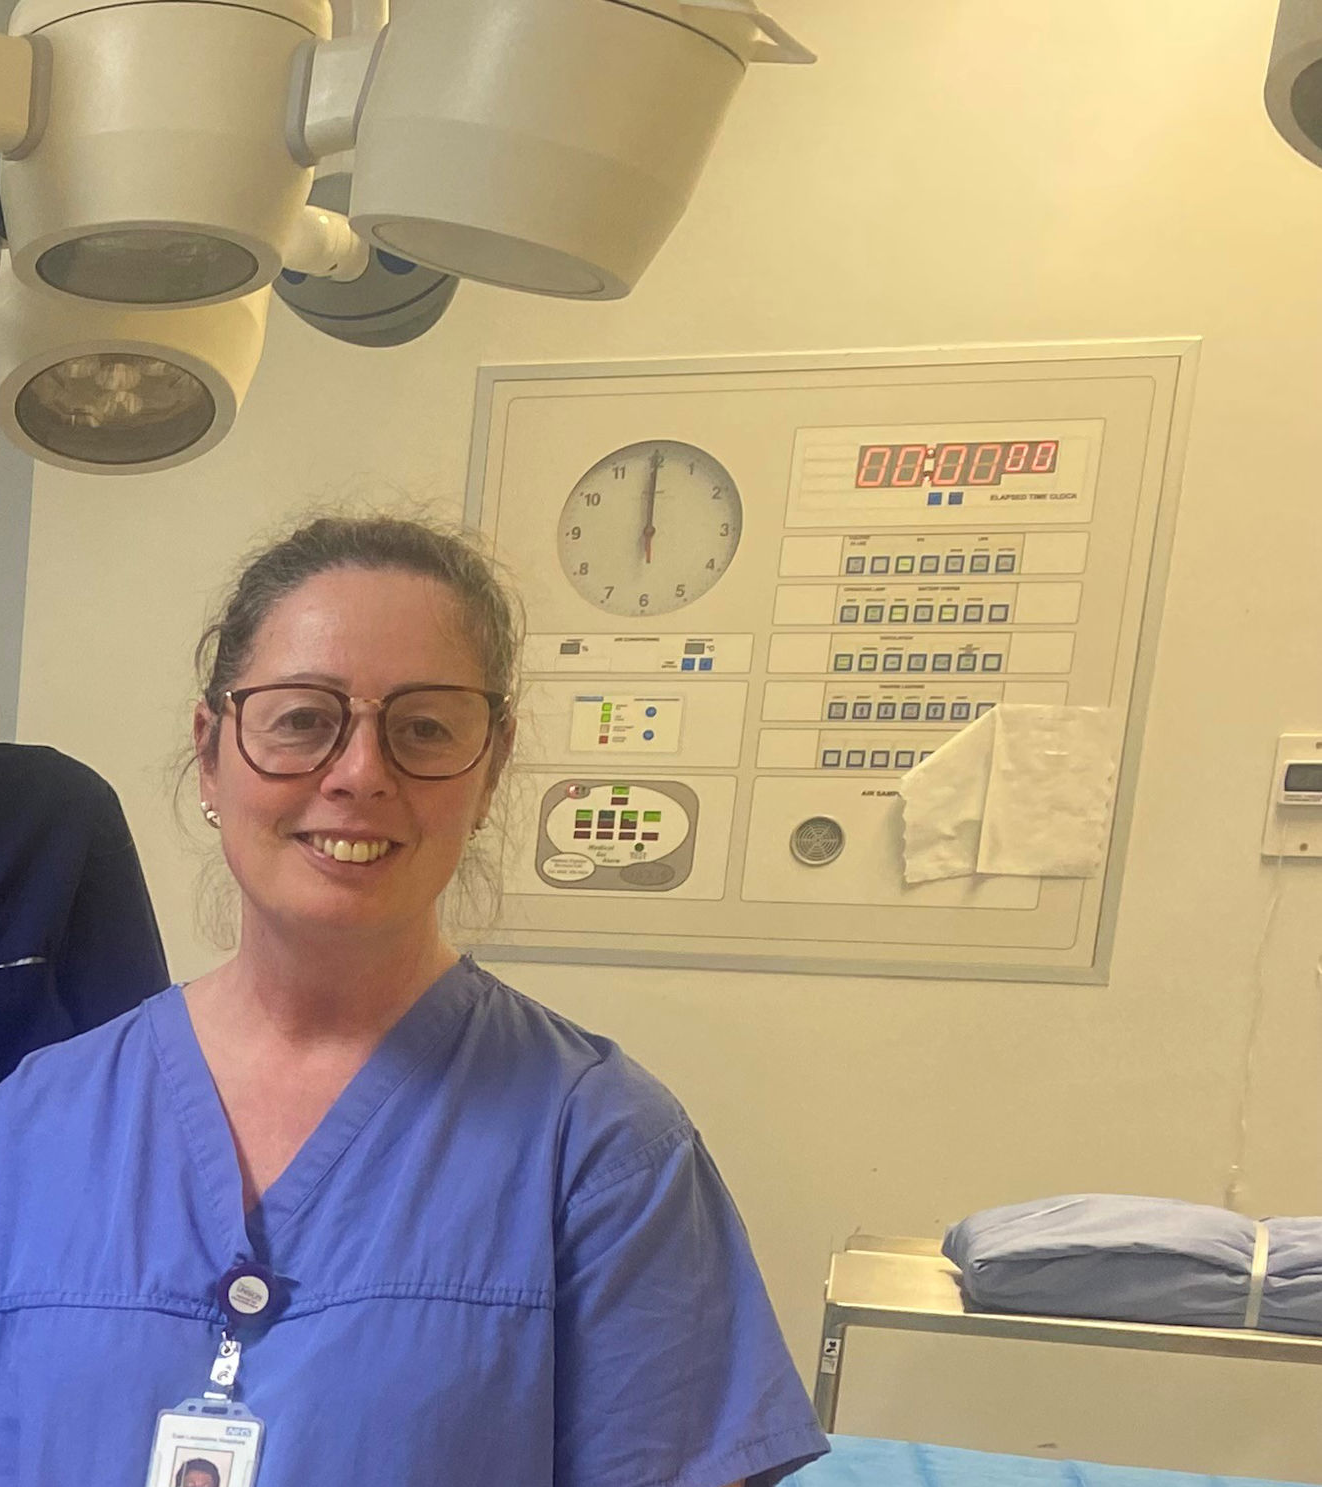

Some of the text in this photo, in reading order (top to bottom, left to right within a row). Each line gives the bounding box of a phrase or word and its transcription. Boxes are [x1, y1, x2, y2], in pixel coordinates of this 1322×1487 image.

[688, 463, 695, 475] 1
[857, 443, 1002, 486] 00:00
[612, 466, 626, 479] 11
[712, 486, 722, 499] 2
[990, 492, 1077, 501] ELAPSED TIME CLOCK
[585, 493, 601, 506] 10
[571, 526, 581, 540] 9
[720, 524, 729, 537] 3
[579, 562, 589, 576] 8
[705, 558, 715, 571] 4
[604, 586, 615, 599] 7
[675, 584, 686, 597] 5
[639, 594, 649, 607] 6
